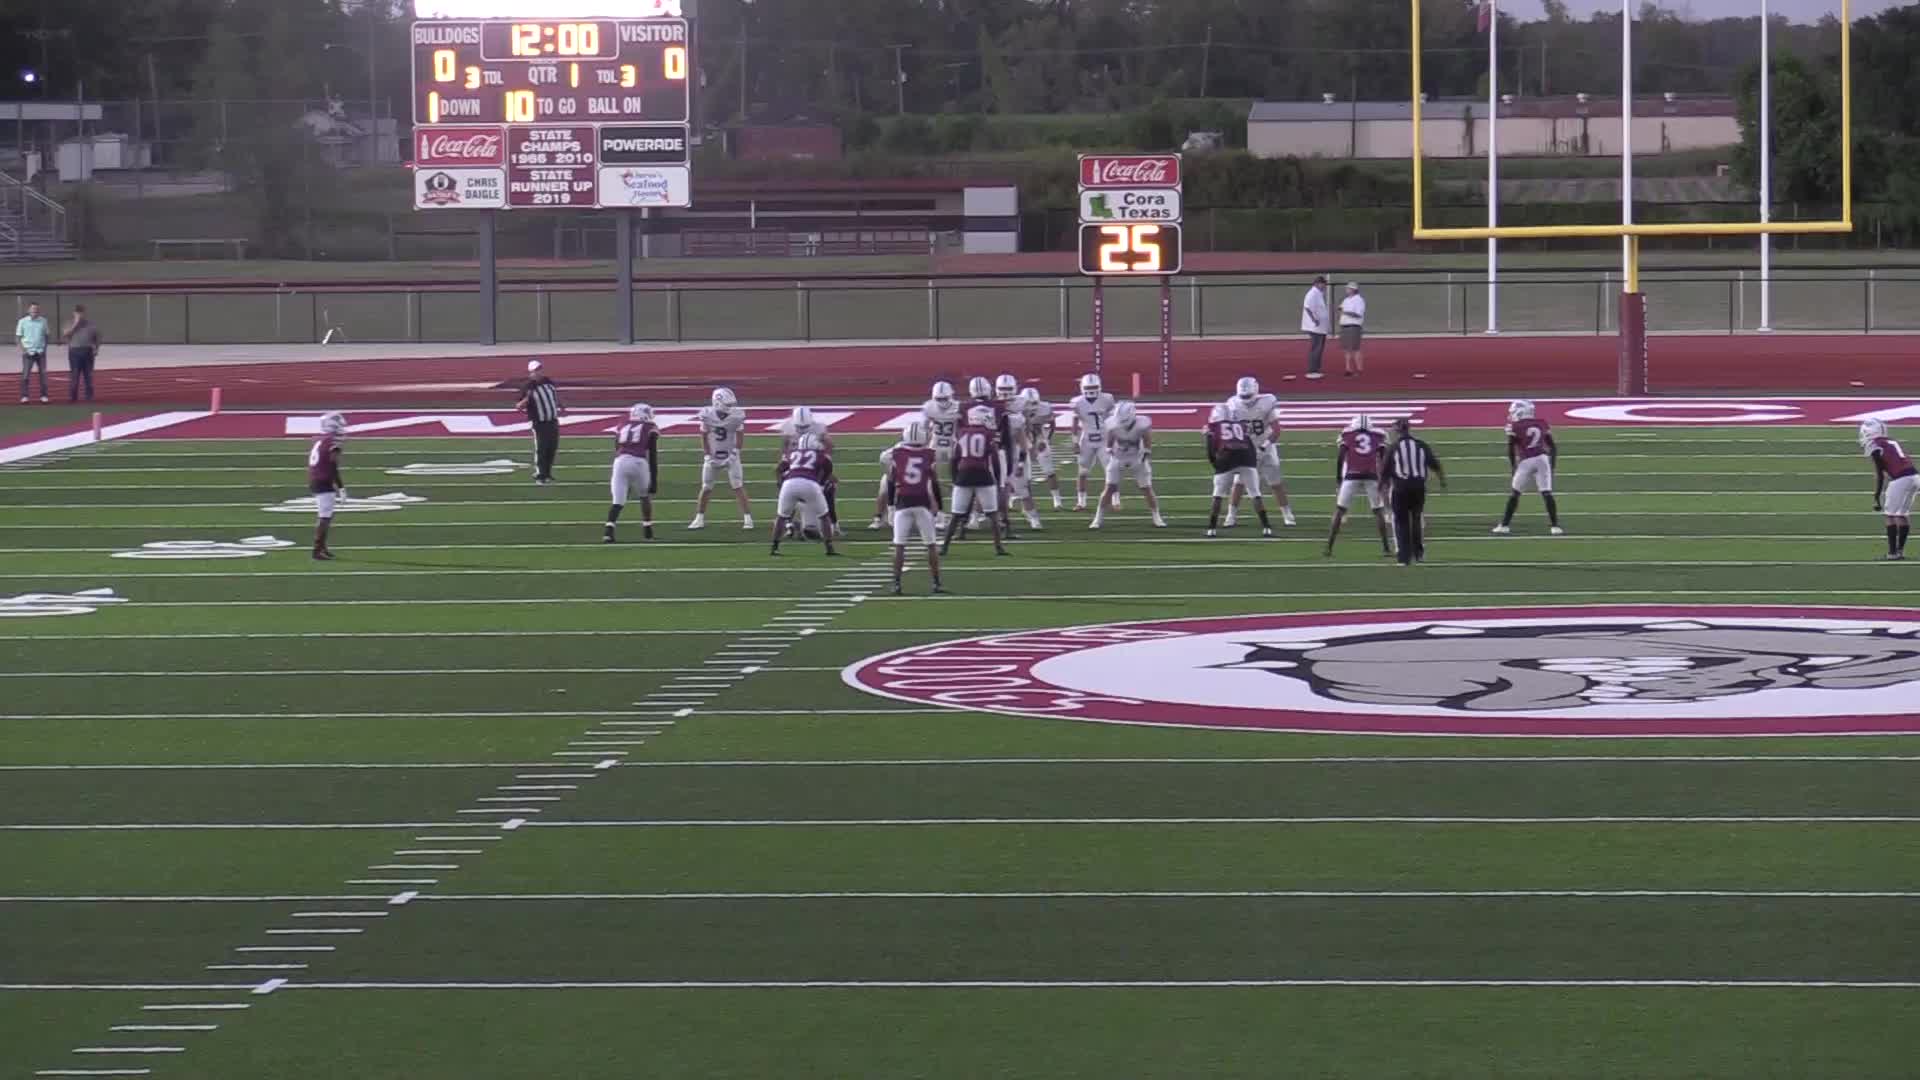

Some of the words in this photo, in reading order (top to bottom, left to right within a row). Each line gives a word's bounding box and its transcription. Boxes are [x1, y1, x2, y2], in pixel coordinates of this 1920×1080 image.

[415, 27, 480, 44] BULLDOGS
[511, 24, 599, 56] 12:00
[620, 25, 685, 42] VISITOR
[434, 50, 456, 82] 0
[664, 47, 685, 79] 0
[464, 66, 480, 89] 3
[483, 71, 504, 85] TOL
[528, 66, 557, 85] QTR
[570, 63, 579, 88] 1
[596, 70, 618, 84] TOL
[620, 65, 635, 87] 3
[428, 91, 439, 123] 1
[440, 99, 480, 115] DOWN
[505, 90, 535, 122] 10
[537, 99, 555, 114] TO
[558, 98, 576, 114] GO
[588, 98, 619, 114] BALL
[623, 97, 641, 113] ON
[529, 130, 573, 141] STATE
[521, 141, 581, 152] CHAMPS
[603, 138, 683, 151] POWERADE
[555, 153, 593, 164] 2010
[467, 178, 498, 188] CHRIS
[530, 170, 573, 181] STATE
[465, 189, 500, 199] DAIGLE
[511, 182, 570, 193] RUNNER
[573, 181, 593, 192] UP
[533, 193, 571, 204] 2019
[1123, 192, 1165, 205] Cora
[1118, 206, 1171, 219] Texas
[1100, 225, 1160, 271] 25
[618, 423, 644, 443] 11
[713, 426, 728, 441] 9
[1220, 422, 1244, 440] 50
[1526, 427, 1541, 448] 2
[959, 433, 986, 457] 10
[1355, 434, 1371, 454] 3
[309, 440, 321, 466] 6
[789, 450, 817, 469] 22
[903, 457, 923, 483] 5
